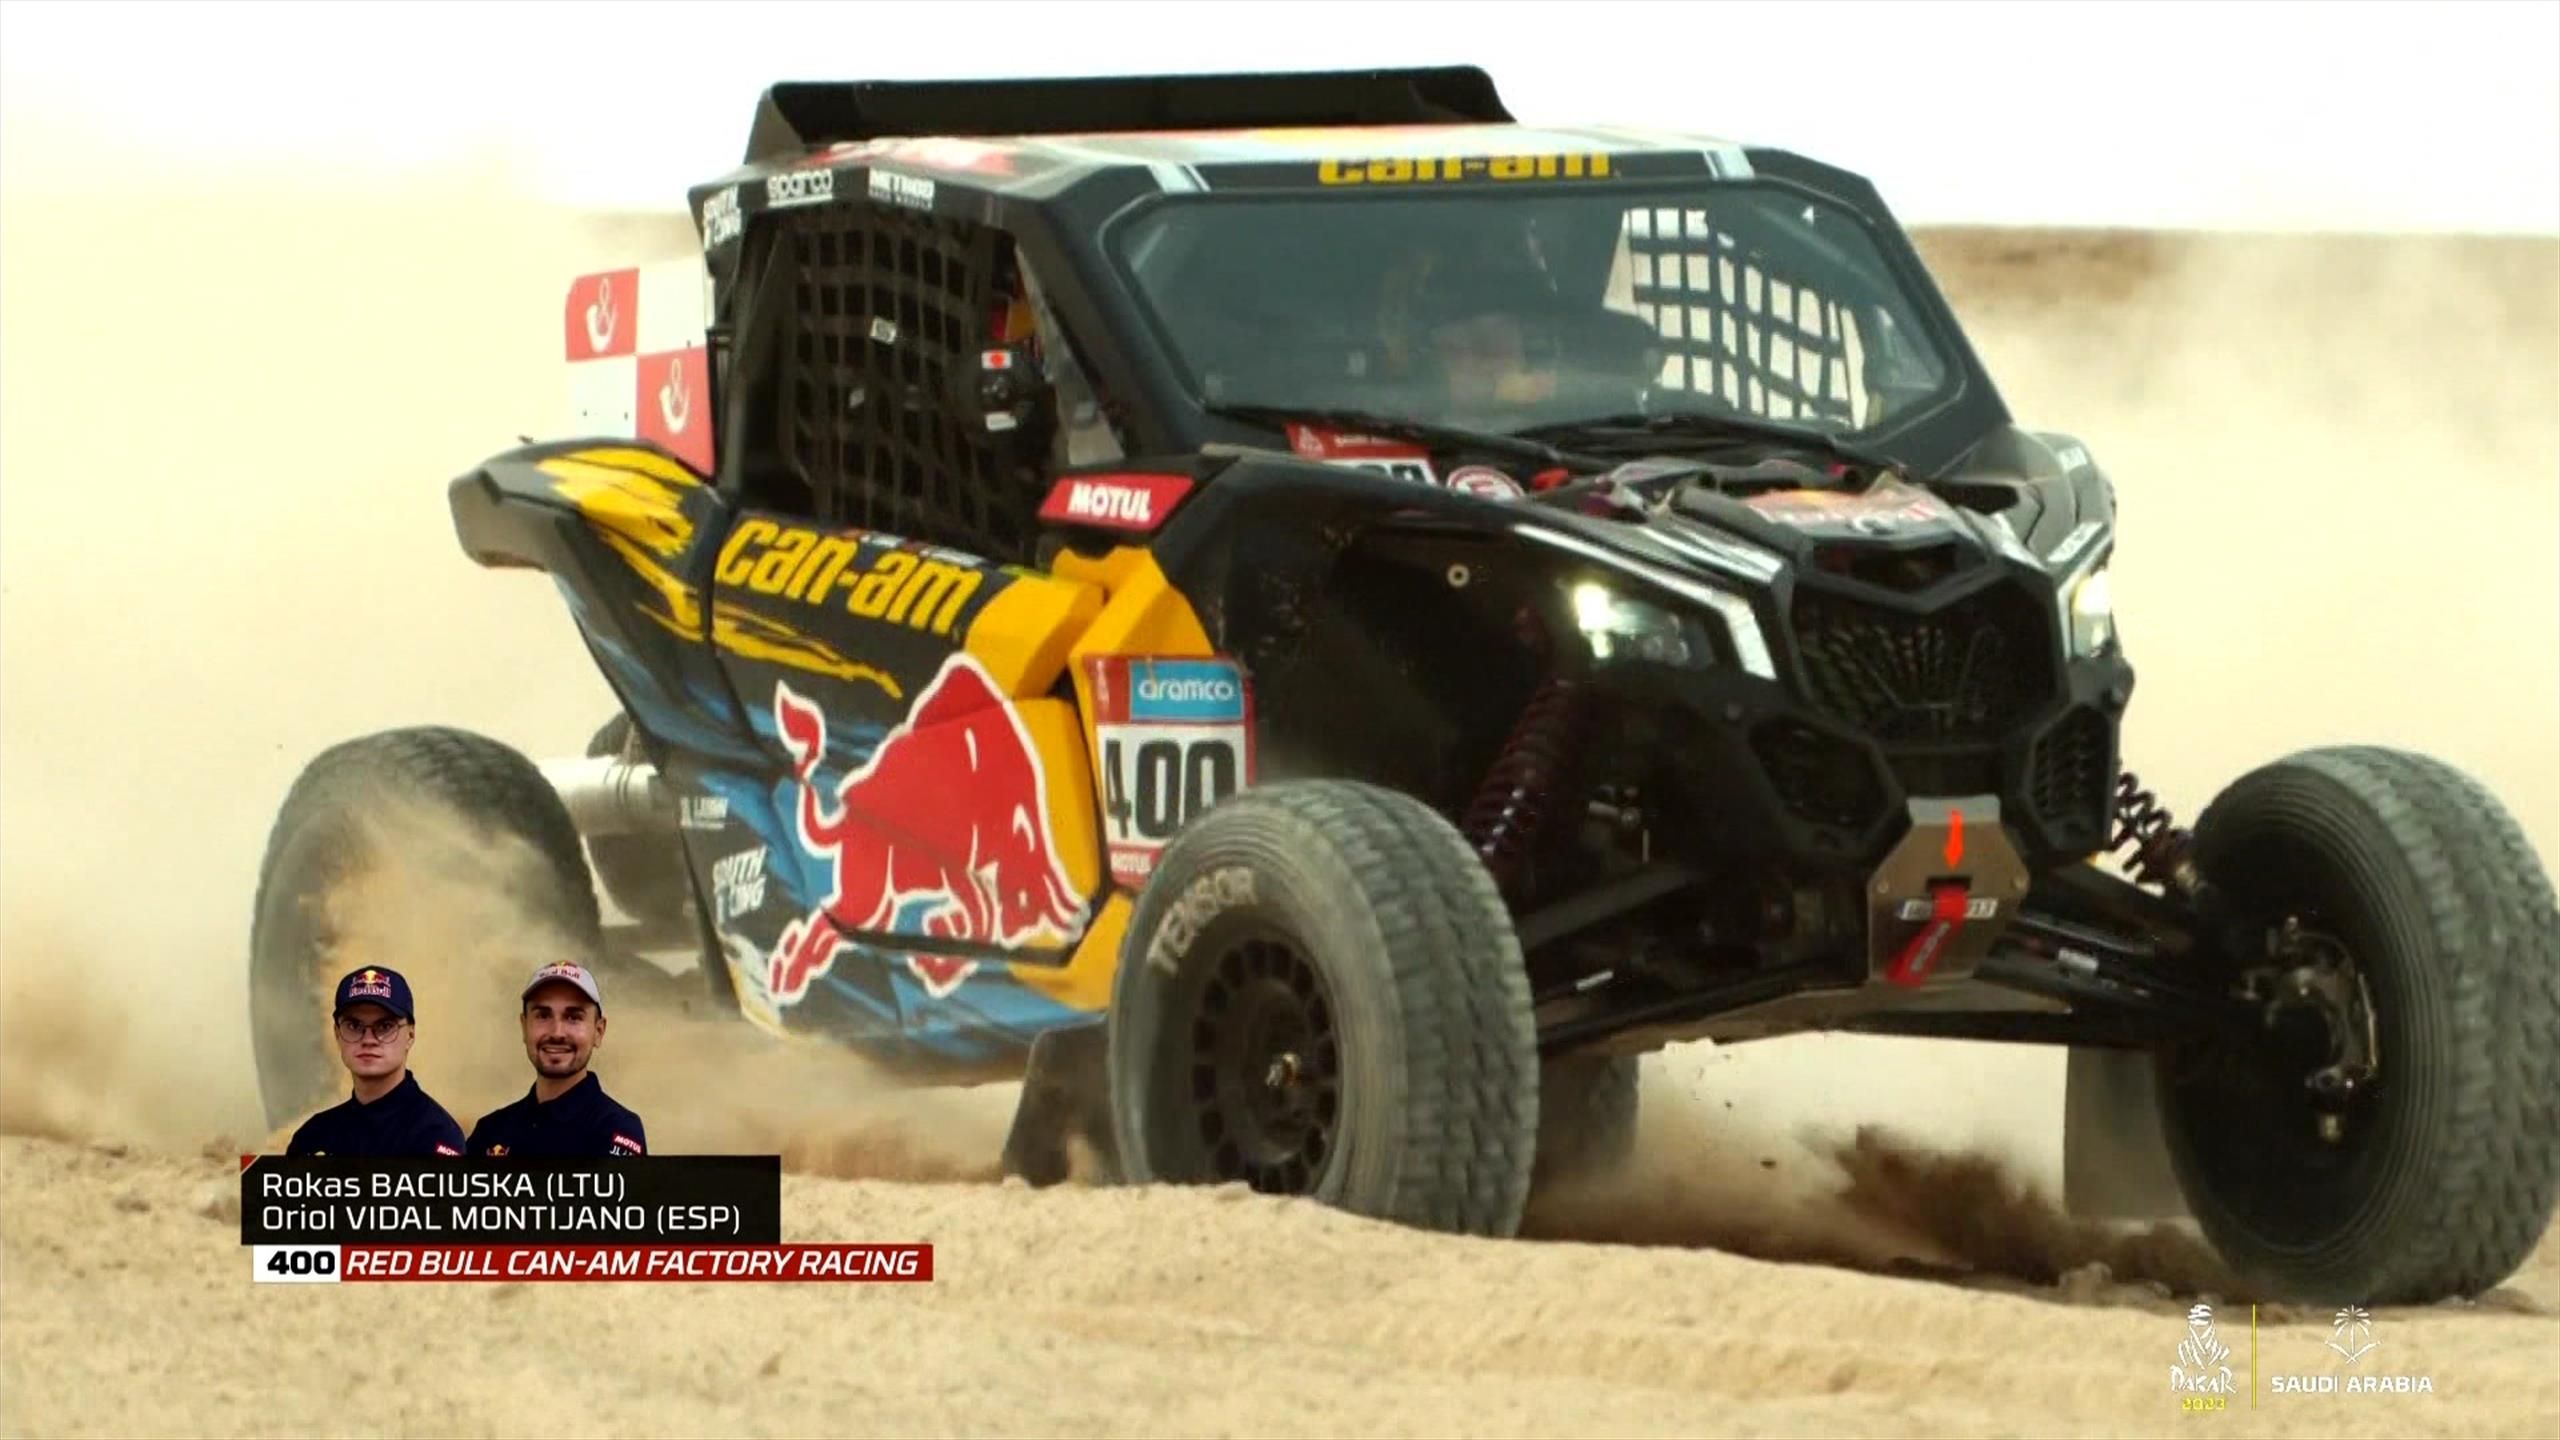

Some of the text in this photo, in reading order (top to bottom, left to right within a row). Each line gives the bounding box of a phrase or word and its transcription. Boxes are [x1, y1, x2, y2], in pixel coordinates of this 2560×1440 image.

[1067, 481, 1152, 521] MOTUL
[714, 518, 984, 636] can-am
[1139, 678, 1233, 702] aramco
[1105, 739, 1237, 838] 400
